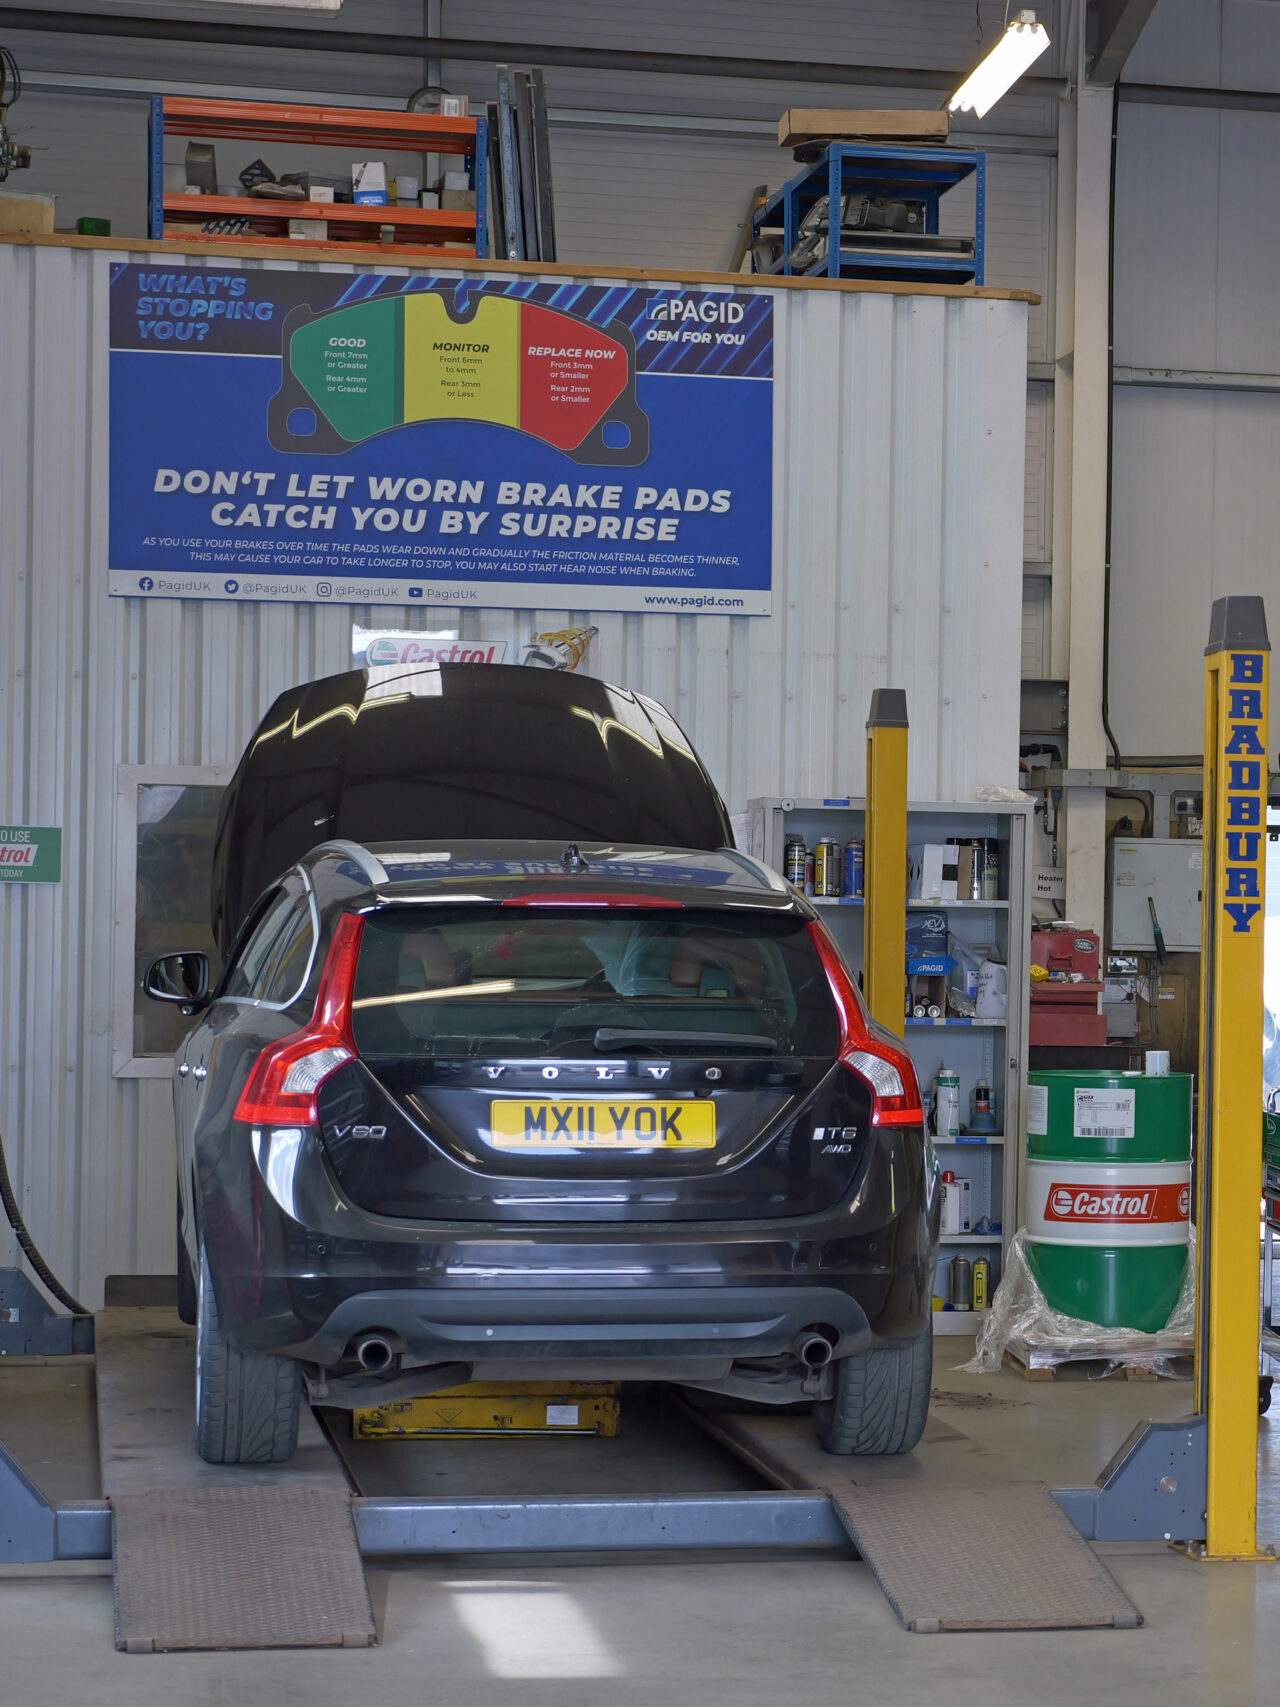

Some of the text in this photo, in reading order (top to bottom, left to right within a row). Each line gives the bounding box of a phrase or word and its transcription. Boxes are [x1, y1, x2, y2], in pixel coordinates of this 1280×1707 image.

[138, 273, 246, 296] WHAT'S
[136, 297, 274, 320] STOPPING
[670, 300, 744, 324] PAGID
[138, 320, 210, 341] YOU?
[646, 330, 745, 345] OEM FOR YOU
[329, 338, 366, 347] GOOD
[433, 342, 489, 353] MONITOR
[528, 347, 616, 359] REPLACE NOW
[154, 469, 731, 513] DON'T LET WORN BRAKE PADS
[212, 502, 679, 541] CATCH YOU BY SURPRISE
[159, 538, 180, 546] YOU
[183, 539, 202, 547] USE
[205, 539, 232, 548] YOUR
[235, 540, 274, 549] BRAKES
[276, 542, 304, 550] OVER
[306, 542, 329, 551] TIME
[332, 543, 351, 552] THE
[353, 544, 379, 553] PADS
[382, 545, 412, 554] WEAR
[414, 546, 446, 555] DOWN
[448, 548, 470, 556] AND
[472, 548, 530, 558] GRADUALLY
[532, 550, 550, 559] THE
[553, 551, 597, 560] FRICTION
[599, 553, 645, 562] MATERIAL
[648, 554, 694, 563] BECOMES
[697, 556, 739, 566] THINNER,
[190, 552, 212, 561] THIS
[238, 554, 271, 563] CAUSE
[274, 555, 301, 563] YOUR
[303, 556, 323, 564] CAR
[326, 557, 339, 565] TO
[342, 557, 366, 566] TAKE
[368, 558, 408, 567] LONGER
[411, 560, 424, 568] TO
[426, 560, 452, 570] STOP,
[456, 561, 476, 569] YOU
[500, 563, 526, 571] ALSO
[528, 563, 558, 572] START
[588, 566, 617, 574] NOISE
[620, 566, 650, 575] WHEN
[652, 567, 696, 576] BRAKING.
[158, 580, 211, 593] PagidUK
[242, 583, 307, 597] @PagidUK
[336, 586, 399, 598] @PagidUK
[427, 589, 477, 600] PagidUK
[645, 596, 743, 608] www.pagid.com
[400, 643, 495, 664] Castrol
[1224, 654, 1266, 932] BRADBURY
[0, 830, 30, 842] O USE
[0, 846, 32, 863] trol
[0, 869, 24, 878] TODAY
[1038, 874, 1064, 882] Heater
[482, 1066, 722, 1080] VOLVO
[524, 1106, 682, 1140] MX11 YOK
[334, 1124, 387, 1139] V60
[828, 1126, 858, 1140] T6
[820, 1144, 852, 1154] AWD
[1073, 1192, 1150, 1215] Castrol
